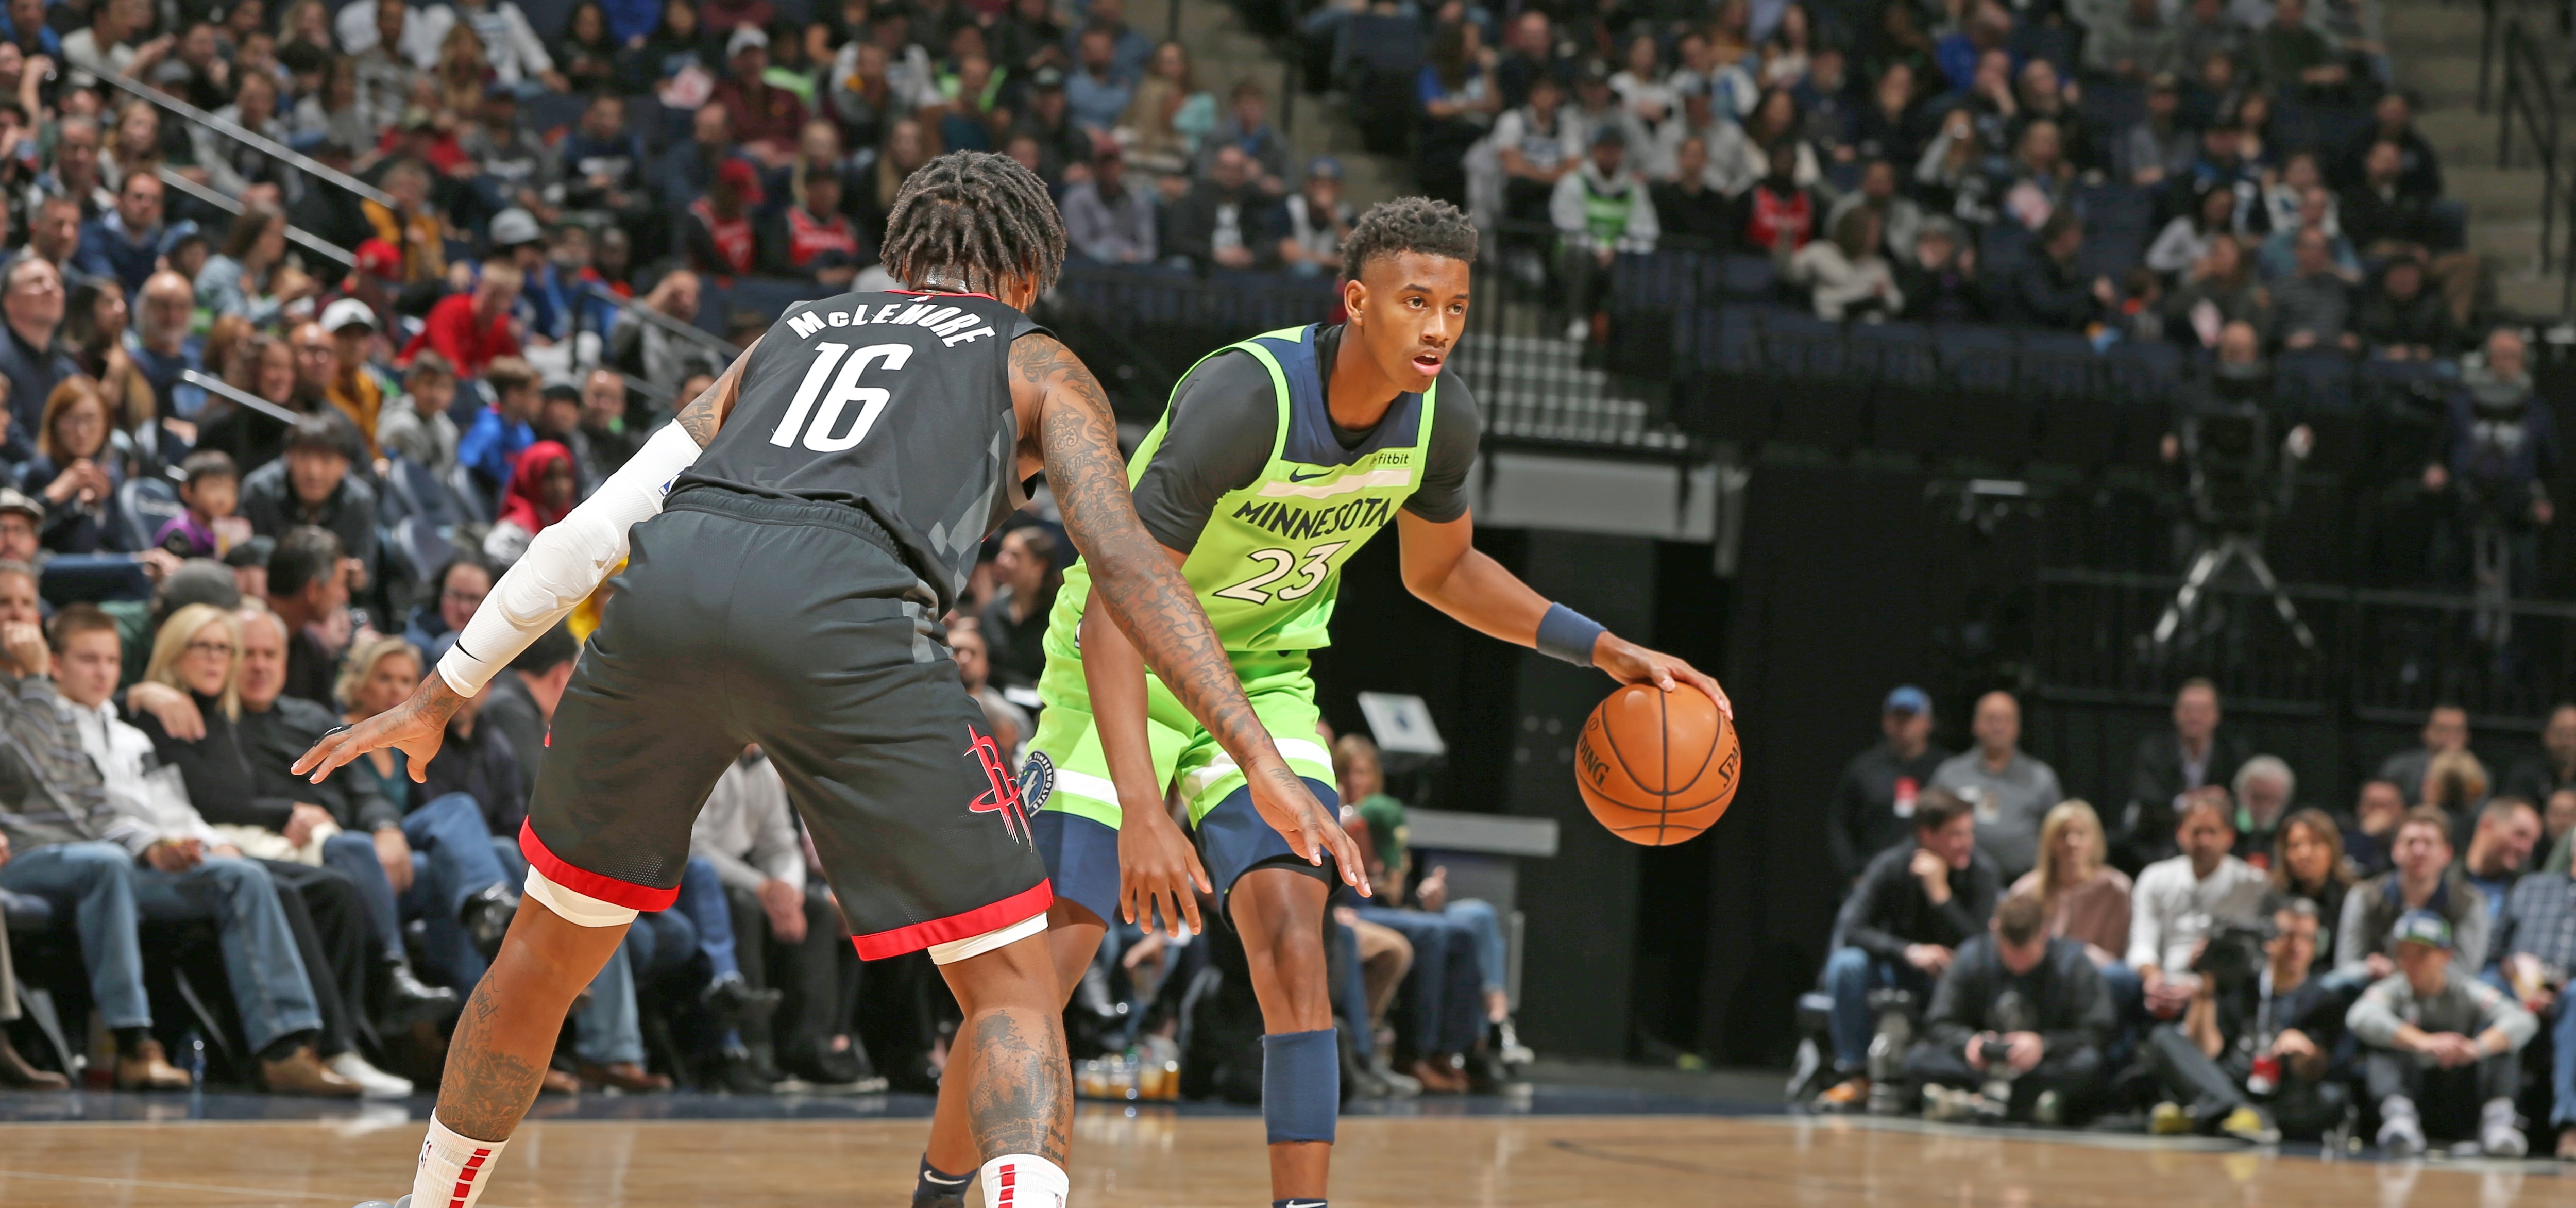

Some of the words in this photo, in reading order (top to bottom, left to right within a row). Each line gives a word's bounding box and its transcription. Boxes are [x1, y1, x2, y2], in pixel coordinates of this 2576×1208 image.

[786, 303, 996, 348] McLEMORE
[769, 341, 913, 452] 16
[1378, 453, 1409, 464] fitbit
[1231, 497, 1391, 540] MINNESOTA
[1211, 540, 1352, 606] 23
[1033, 752, 1053, 810] TIMBERWOLVES
[1579, 731, 1611, 787] DING
